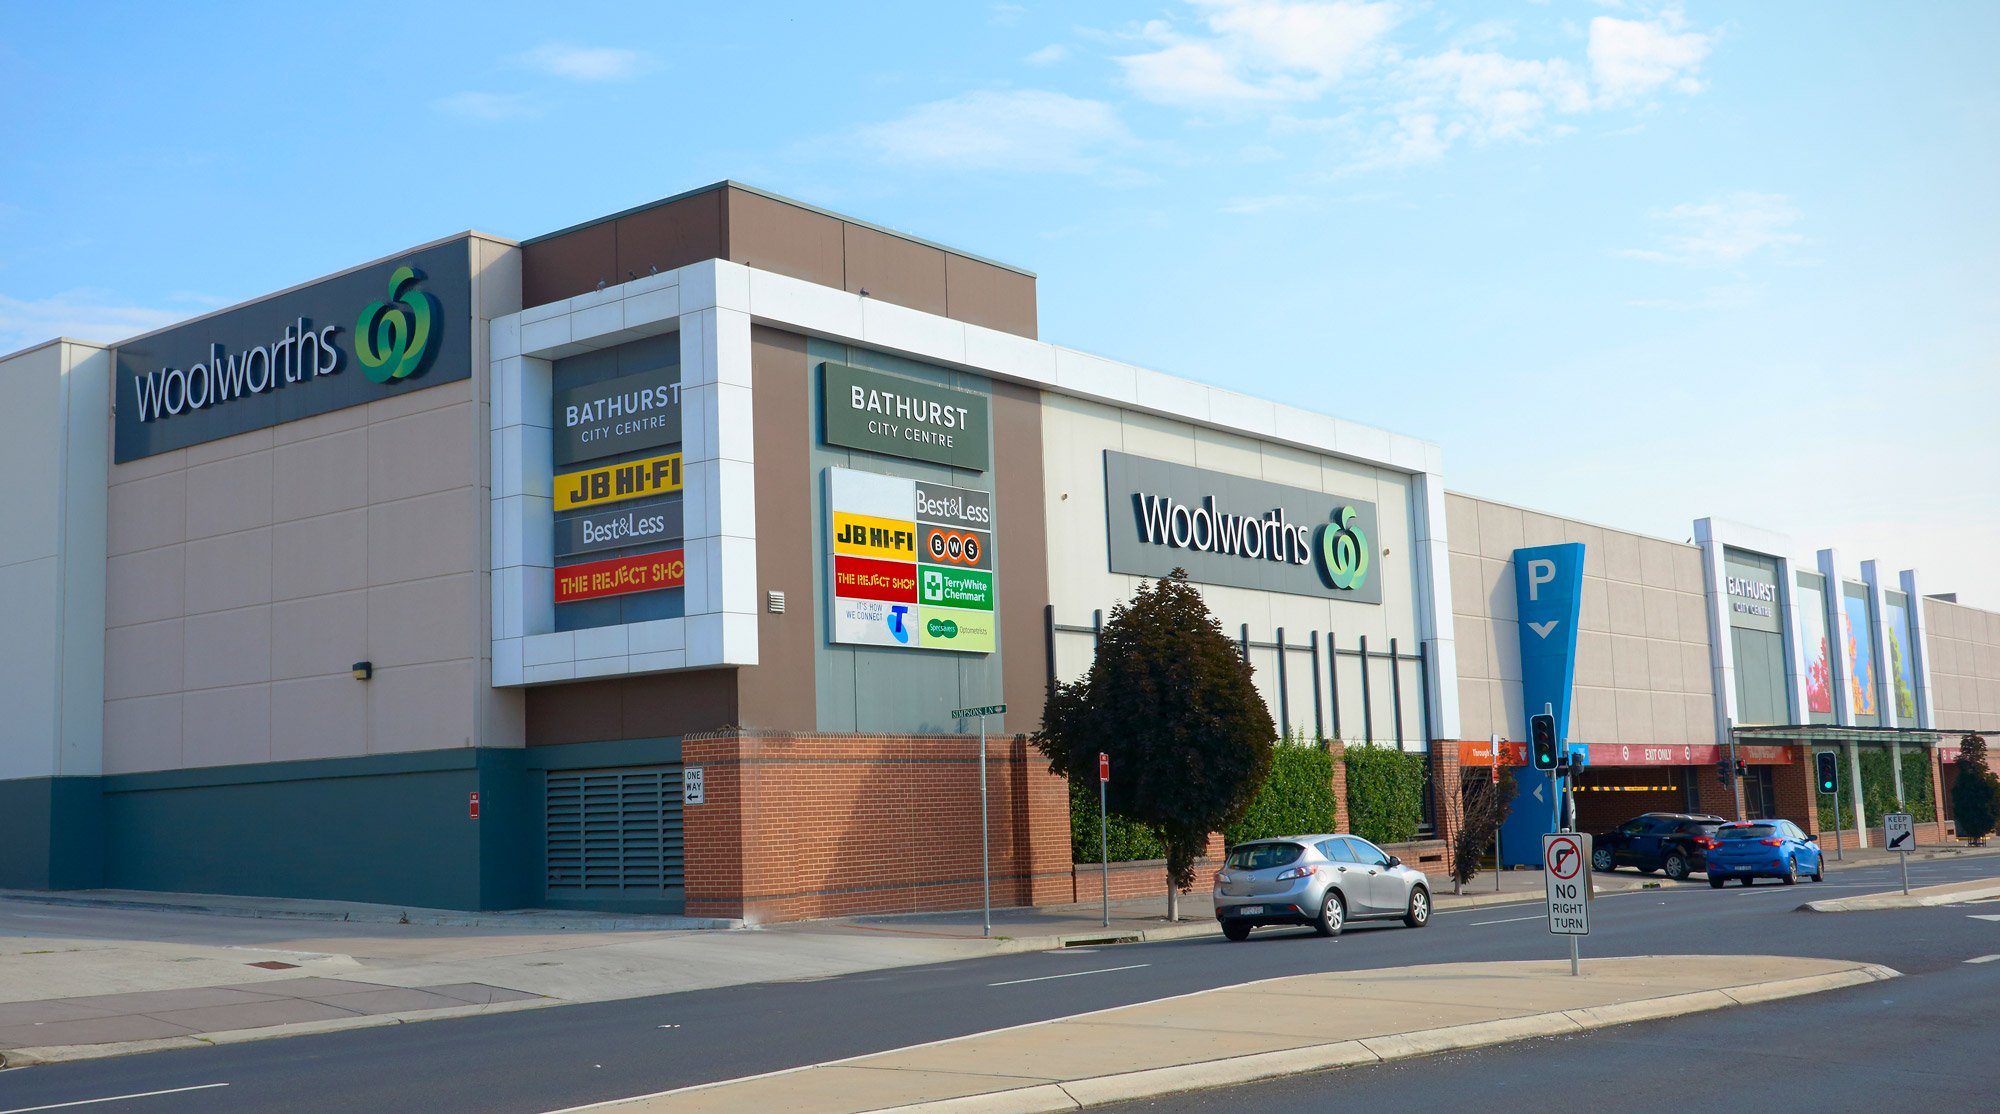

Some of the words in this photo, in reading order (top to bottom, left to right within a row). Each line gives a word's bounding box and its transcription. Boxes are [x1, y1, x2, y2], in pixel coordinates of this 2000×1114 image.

[135, 317, 338, 422] Woolworths
[566, 382, 682, 427] BATHURST
[851, 385, 968, 431] BATHURST
[581, 426, 610, 443] CITY
[615, 414, 666, 436] CENTRE
[868, 420, 899, 438] CITY
[904, 428, 954, 448] CENTRE
[570, 471, 610, 503] JB
[916, 489, 989, 523] Best&Less
[583, 512, 665, 544] Best&Less
[837, 523, 867, 546] JB
[1138, 492, 1311, 565] Woolworths
[561, 575, 588, 595] THE
[592, 564, 648, 591] REJECT
[652, 560, 684, 582] SHO
[837, 572, 855, 585] THE
[857, 573, 890, 587] REJECT
[892, 577, 915, 590] SHOP
[944, 576, 988, 592] TerryWhite
[1527, 558, 1557, 601] P
[944, 588, 985, 602] Chemmart
[1728, 576, 1776, 602] BATHURST
[846, 609, 856, 619] WE
[856, 611, 883, 621] CONNECT
[856, 601, 868, 611] IT'S
[869, 603, 883, 612] HOW
[1736, 602, 1749, 614] CITY
[1750, 604, 1772, 617] CENTRE
[952, 708, 982, 718] SIMPSONS
[1472, 748, 1490, 759] Through
[1644, 748, 1657, 760] EXIT
[1657, 748, 1672, 760] ONLY
[686, 771, 701, 780] ONE
[686, 783, 702, 791] WAY
[1889, 823, 1907, 831] LEFT
[1555, 884, 1577, 899] NO
[1552, 903, 1583, 914] RIGHT
[1554, 917, 1583, 929] TURN
